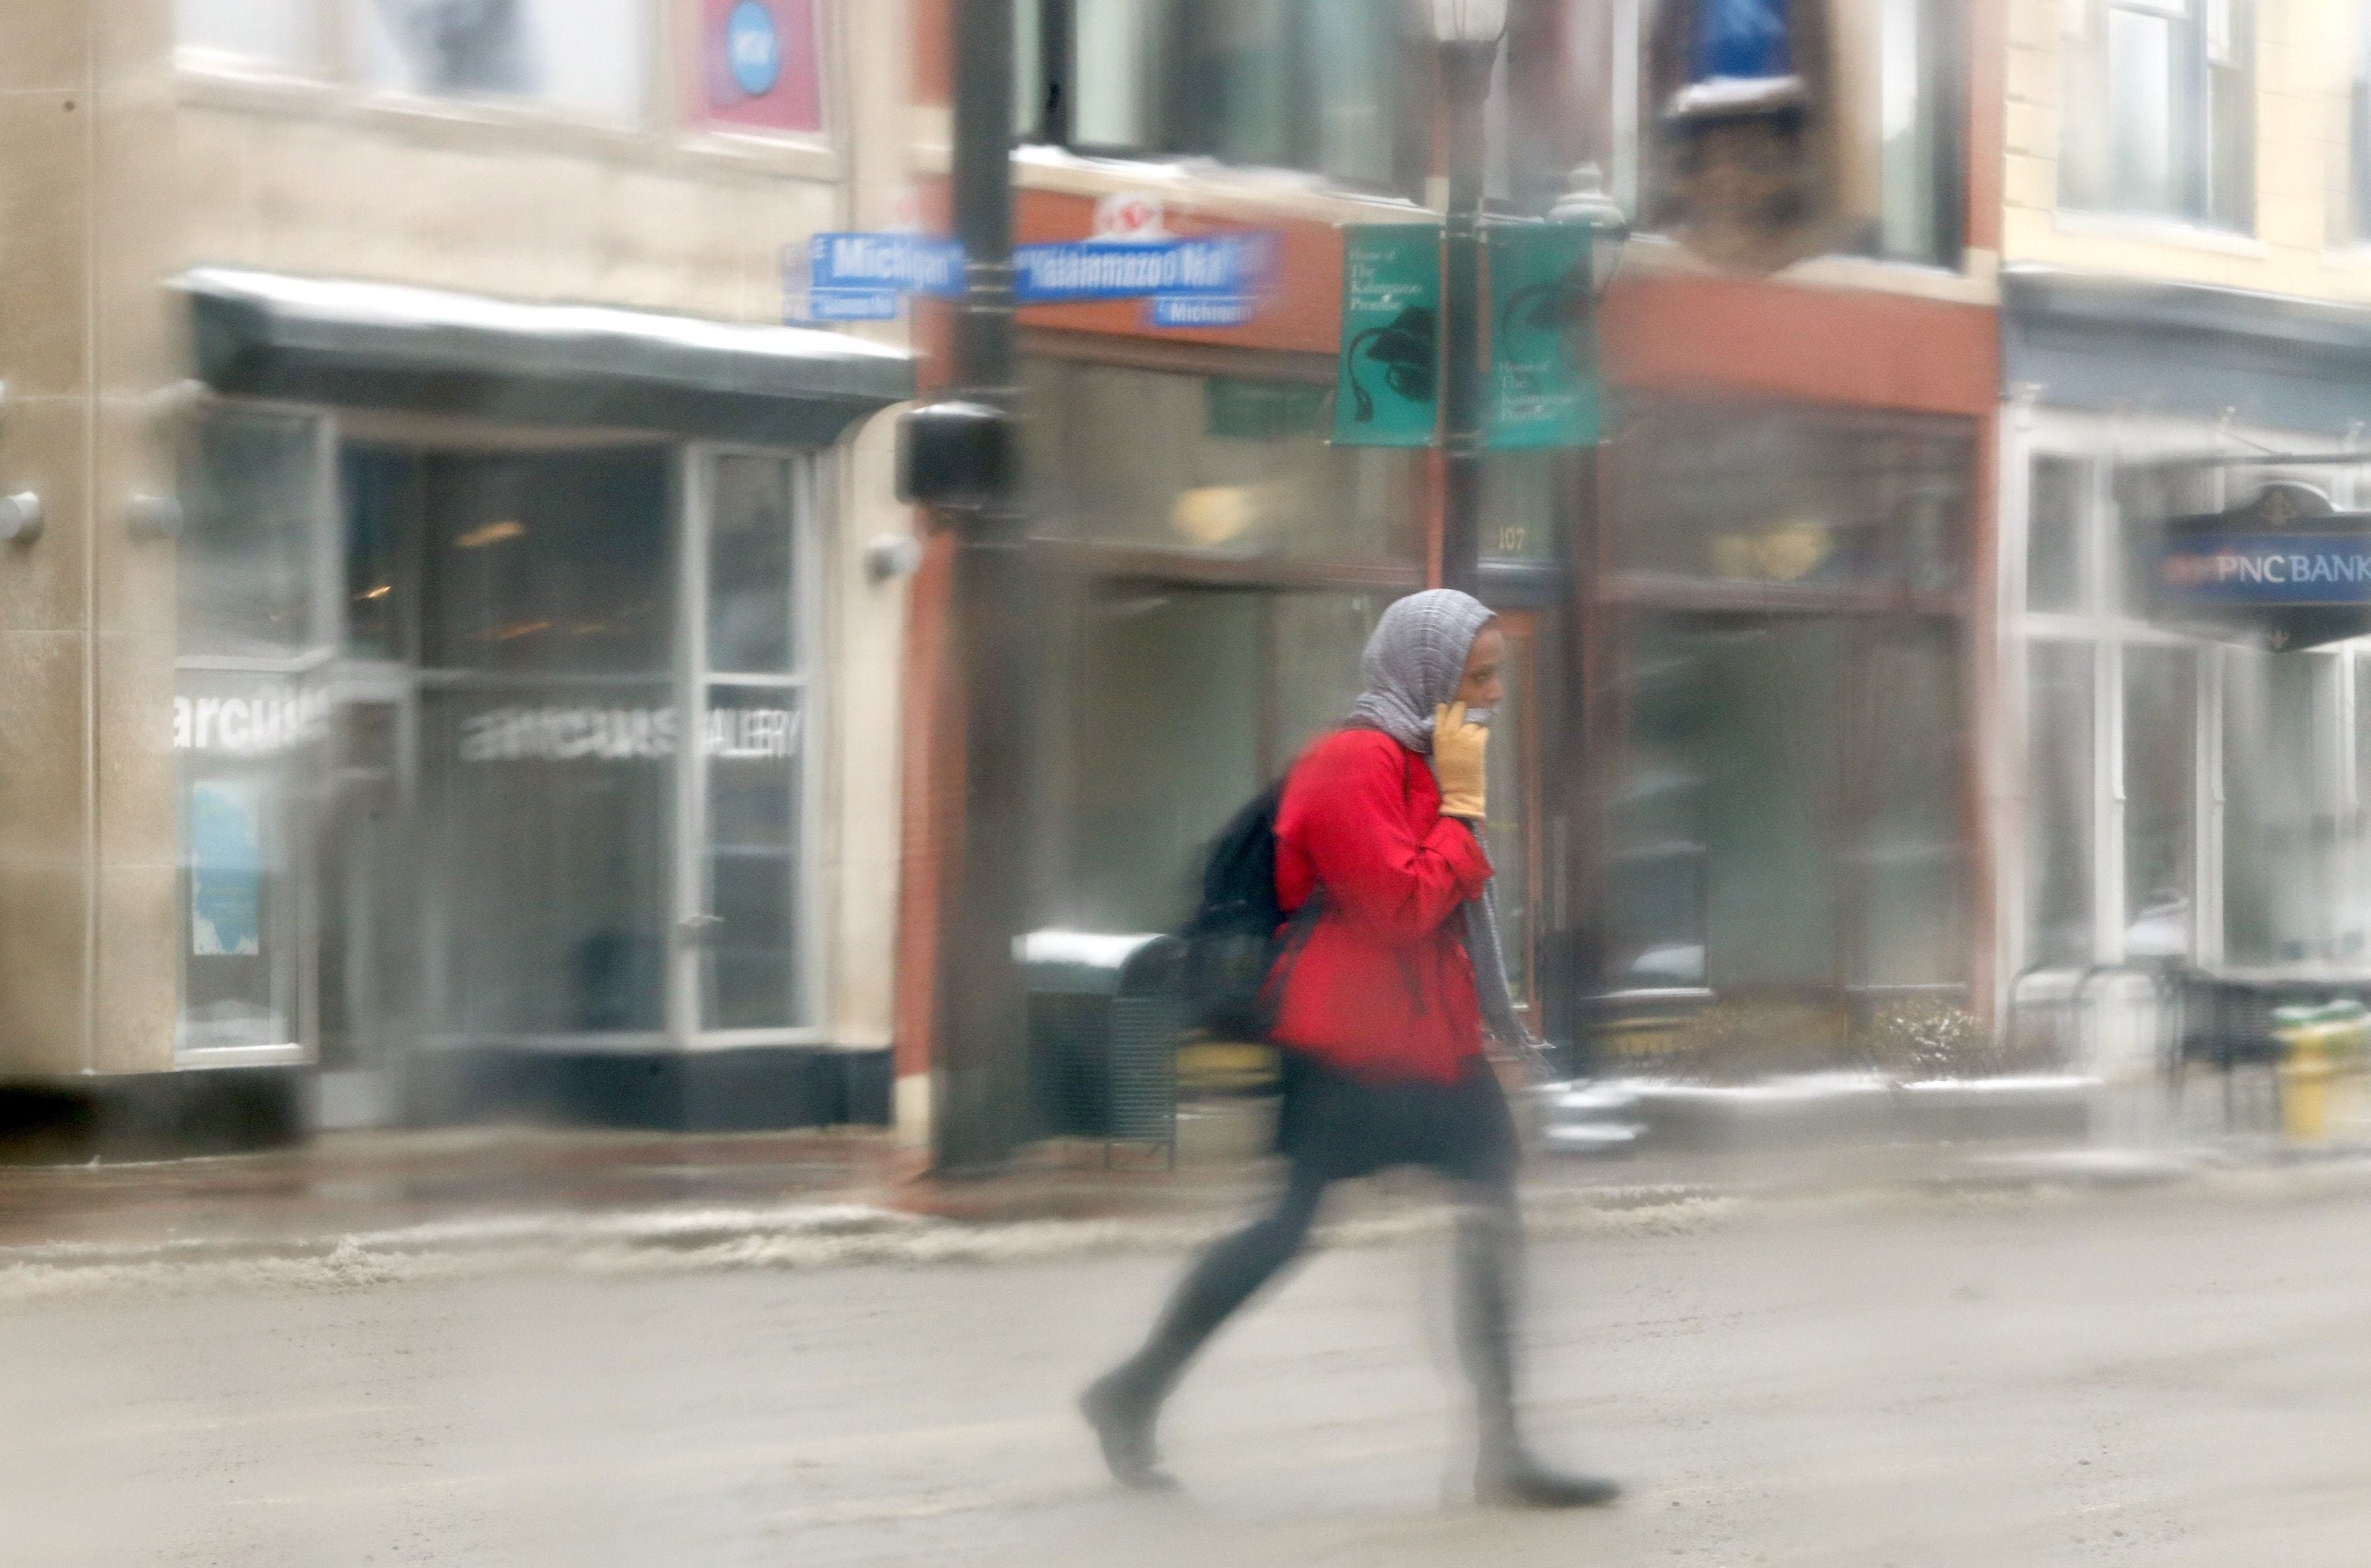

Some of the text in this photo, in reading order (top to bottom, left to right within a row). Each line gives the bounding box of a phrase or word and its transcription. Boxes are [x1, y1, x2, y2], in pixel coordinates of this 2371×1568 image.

[1499, 526, 1525, 550] 107
[2216, 555, 2371, 583] PNC BANK
[706, 708, 803, 757] ALLERY
